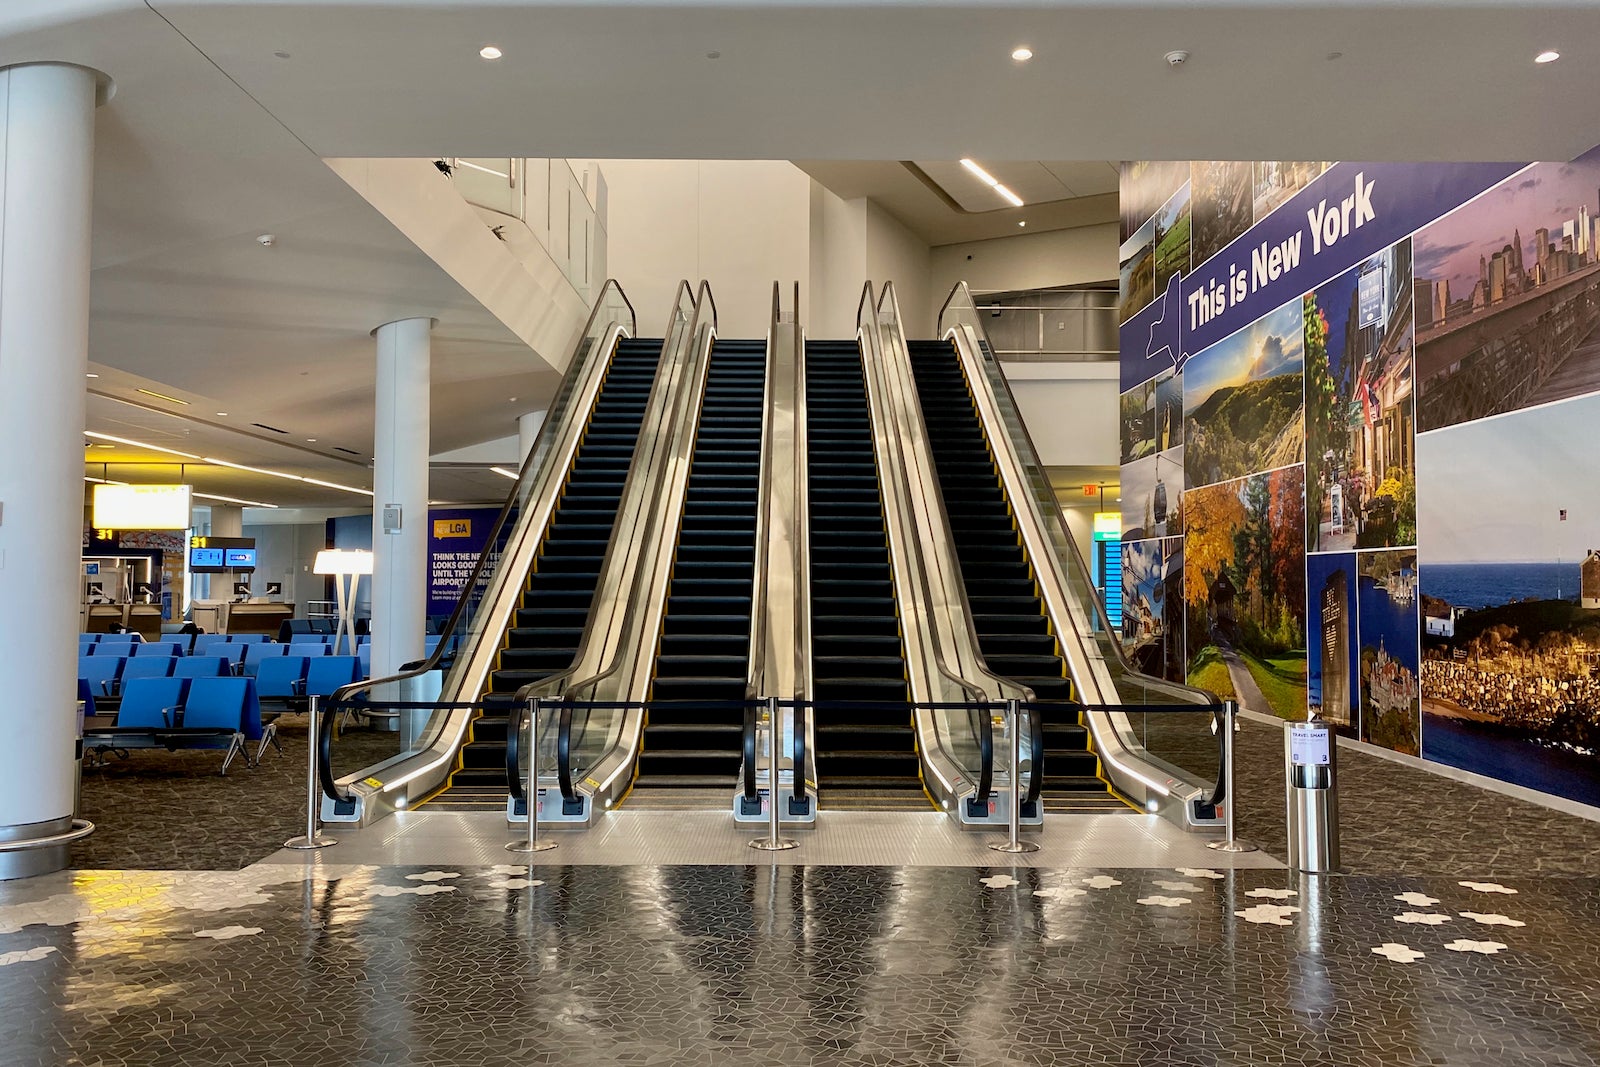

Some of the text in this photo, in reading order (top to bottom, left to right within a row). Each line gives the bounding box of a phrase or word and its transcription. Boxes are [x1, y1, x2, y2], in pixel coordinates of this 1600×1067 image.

[1188, 171, 1376, 331] This is New York
[449, 523, 467, 533] LGA
[97, 529, 113, 540] 31
[191, 536, 207, 549] 31
[432, 561, 457, 569] LOOKS
[432, 578, 465, 586] AIRPORT
